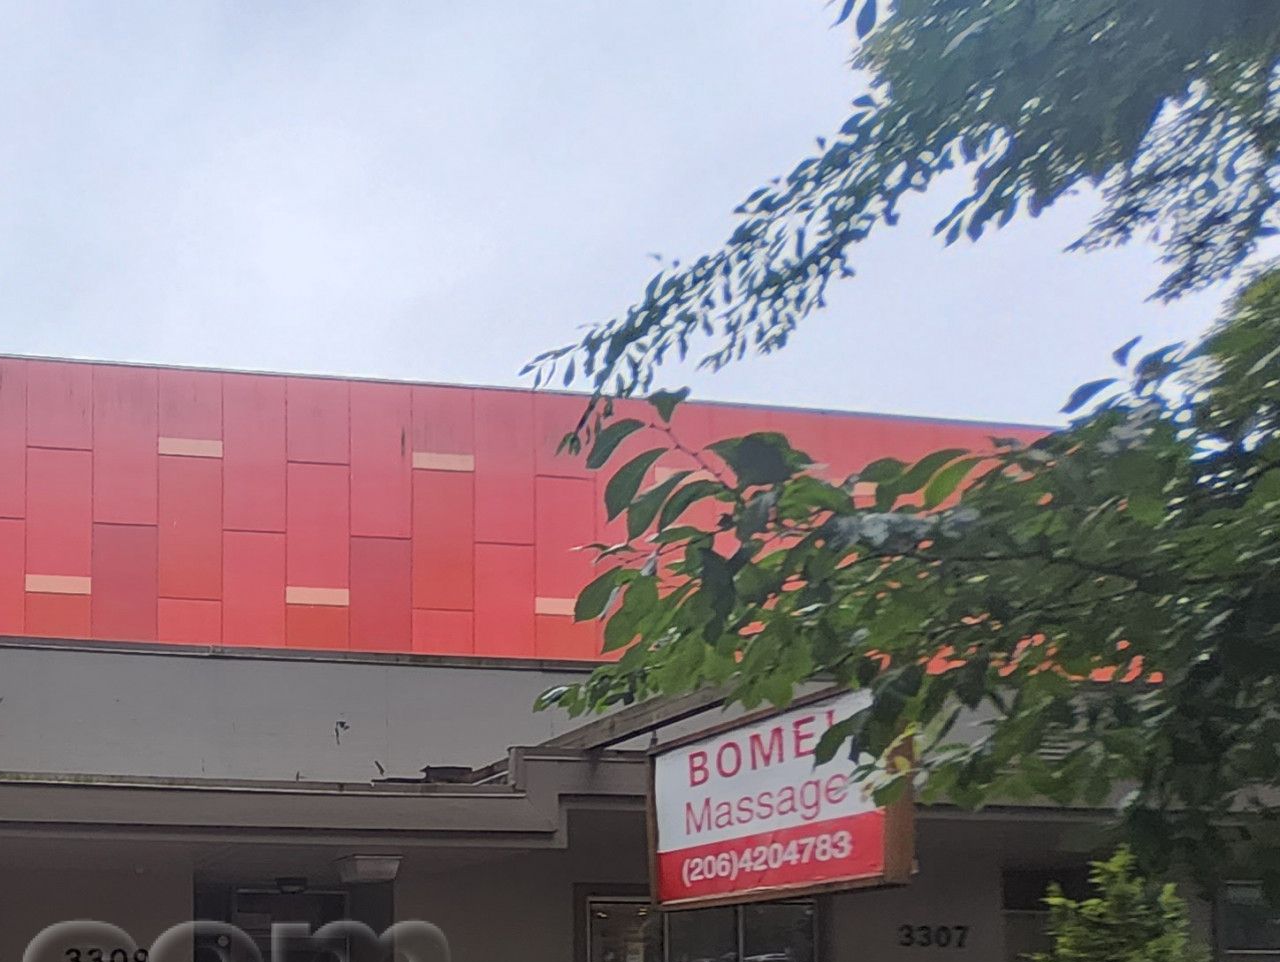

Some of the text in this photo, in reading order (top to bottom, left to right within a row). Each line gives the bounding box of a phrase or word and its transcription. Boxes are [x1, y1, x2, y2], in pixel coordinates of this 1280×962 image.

[684, 773, 849, 836] Massage
[681, 830, 853, 887] (206)4204783
[897, 924, 969, 948] 3307
